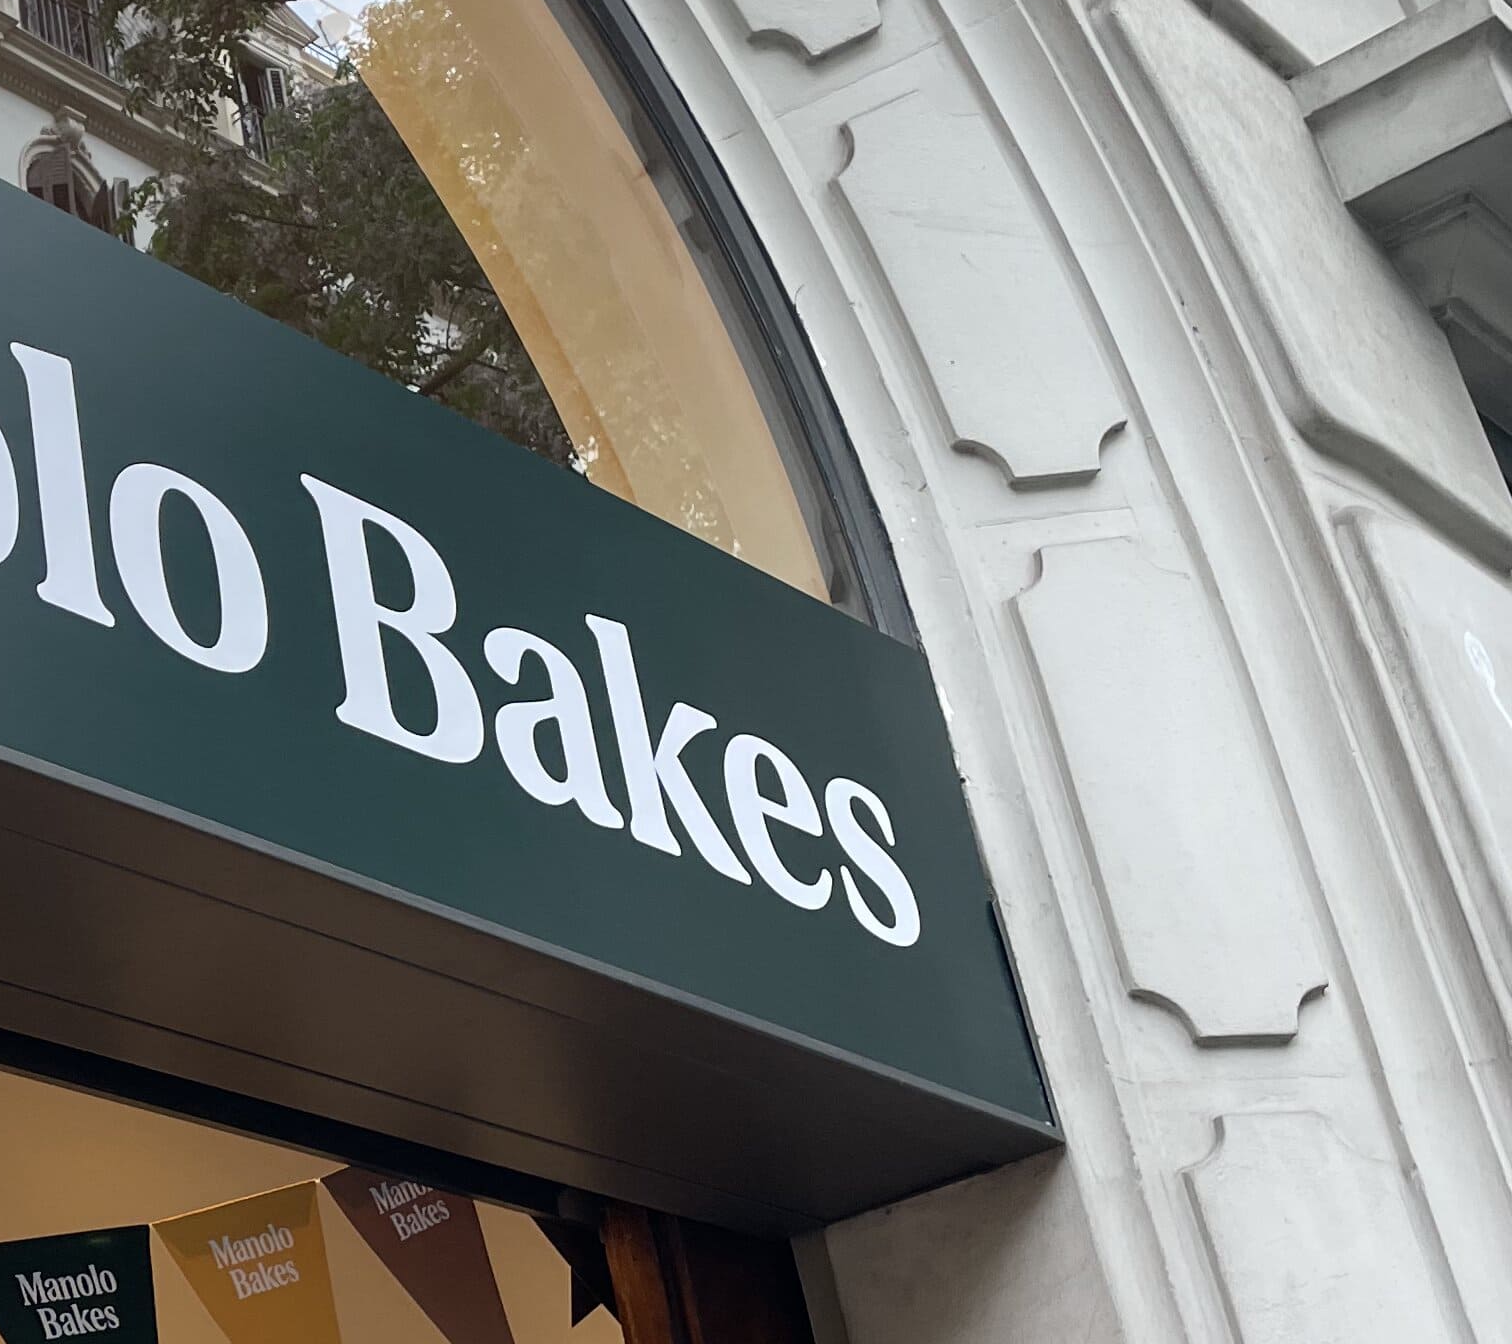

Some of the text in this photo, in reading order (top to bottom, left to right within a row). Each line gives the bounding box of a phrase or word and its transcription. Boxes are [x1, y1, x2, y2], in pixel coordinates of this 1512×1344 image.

[299, 472, 920, 948] Bakes
[390, 1199, 450, 1242] Bakes
[208, 1224, 294, 1269] Manolo
[14, 1263, 118, 1306] Manolo
[229, 1260, 300, 1300] Bakes
[36, 1303, 120, 1340] Bakes
